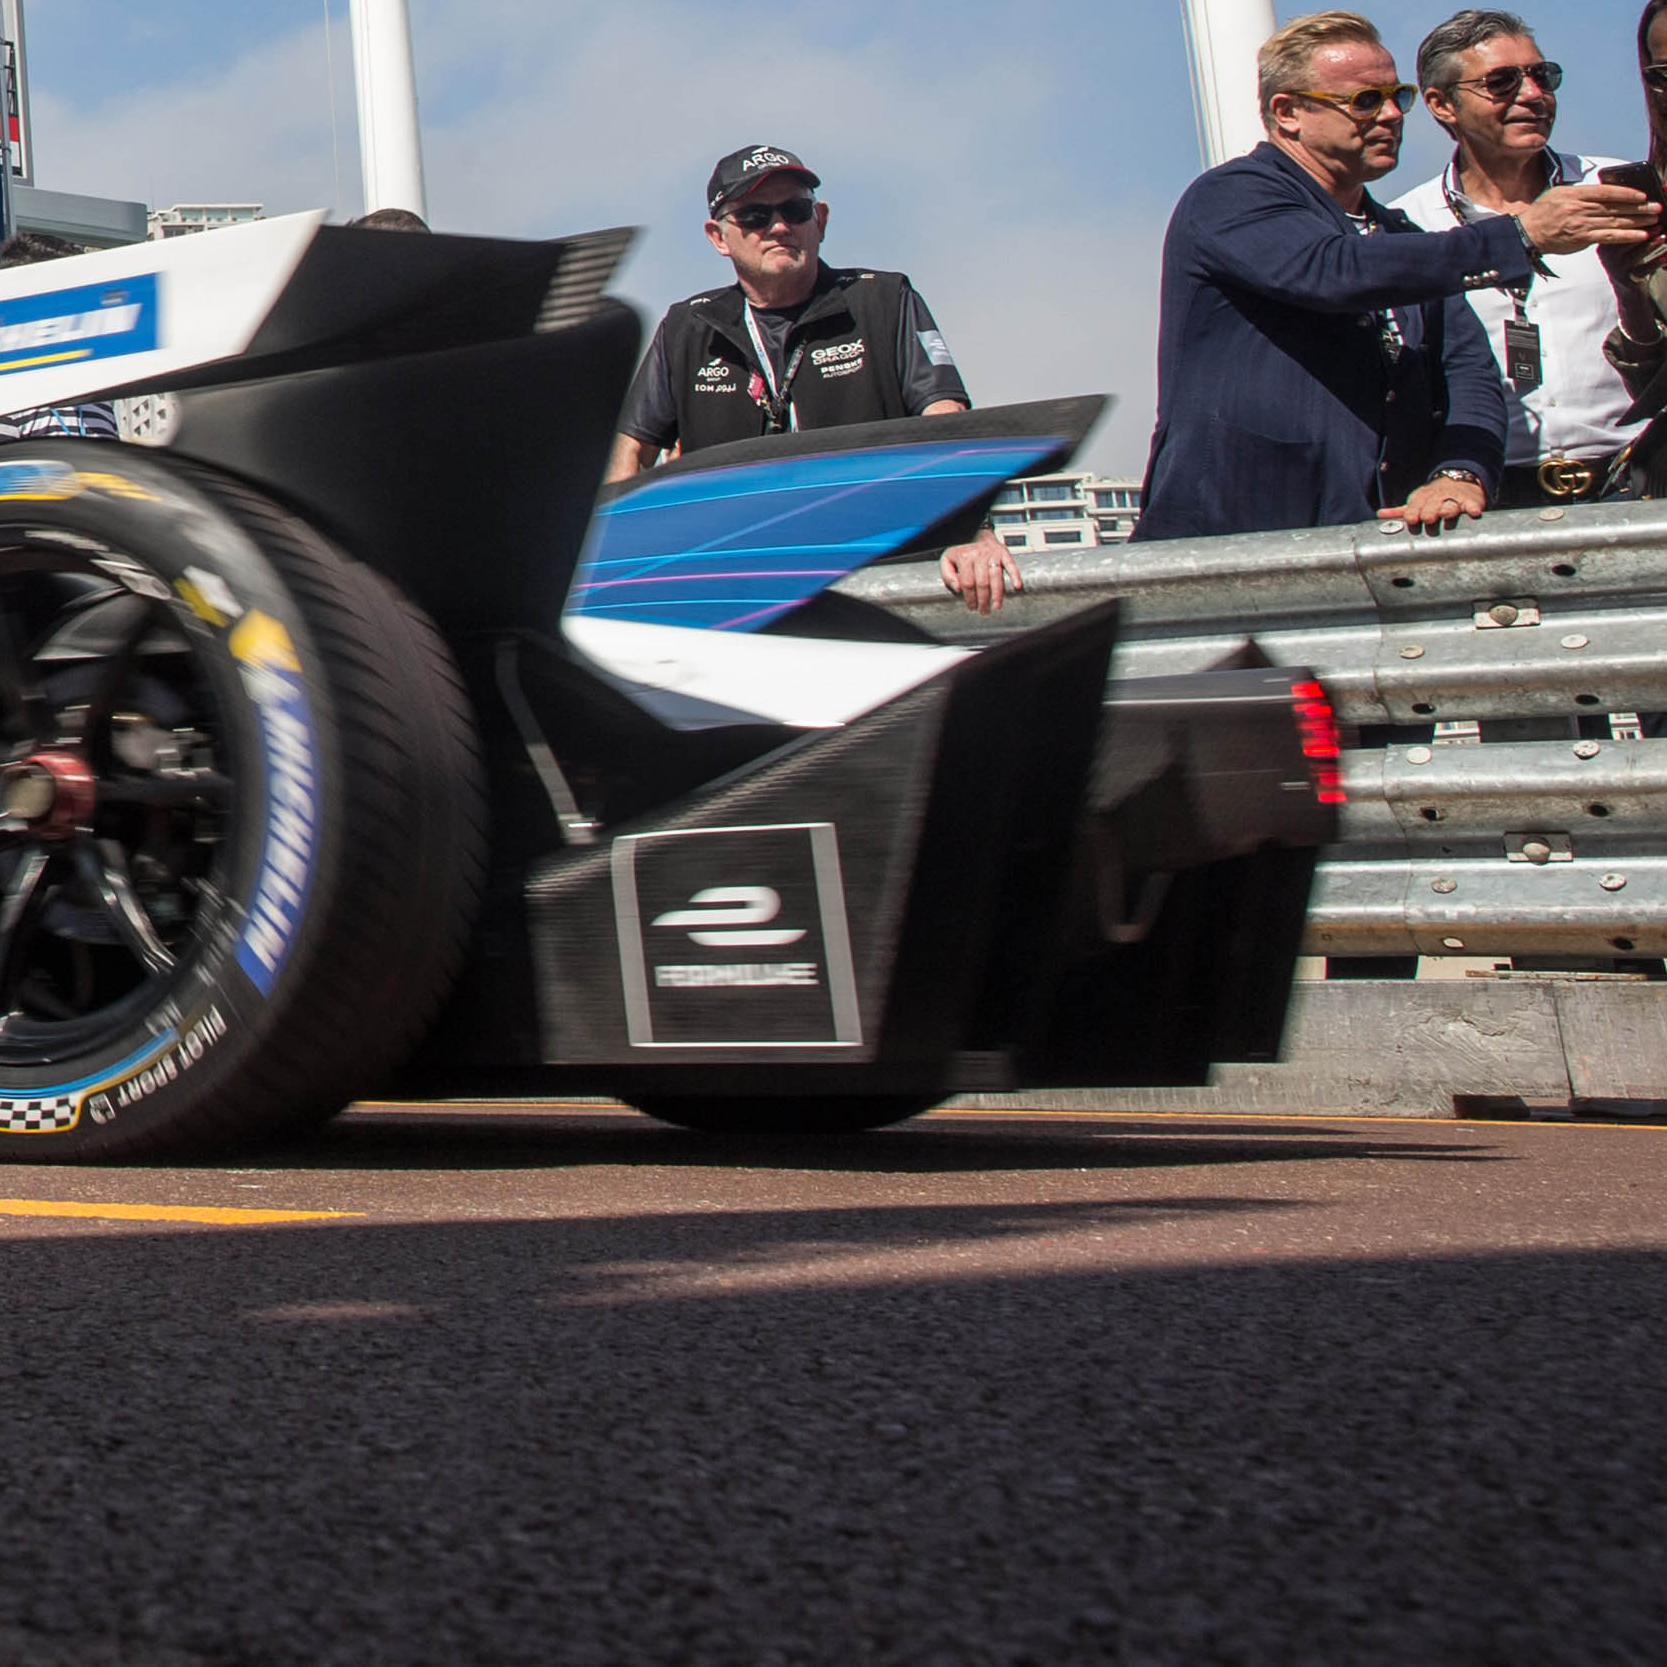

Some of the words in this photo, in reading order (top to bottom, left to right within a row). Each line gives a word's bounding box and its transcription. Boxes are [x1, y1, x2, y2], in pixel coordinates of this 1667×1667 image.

[743, 152, 790, 172] ARGO
[811, 338, 865, 359] GEOX
[697, 366, 730, 377] ARGO
[243, 703, 316, 975] MICHELIN
[178, 1003, 228, 1072] PILOT
[117, 1053, 180, 1109] SPORT
